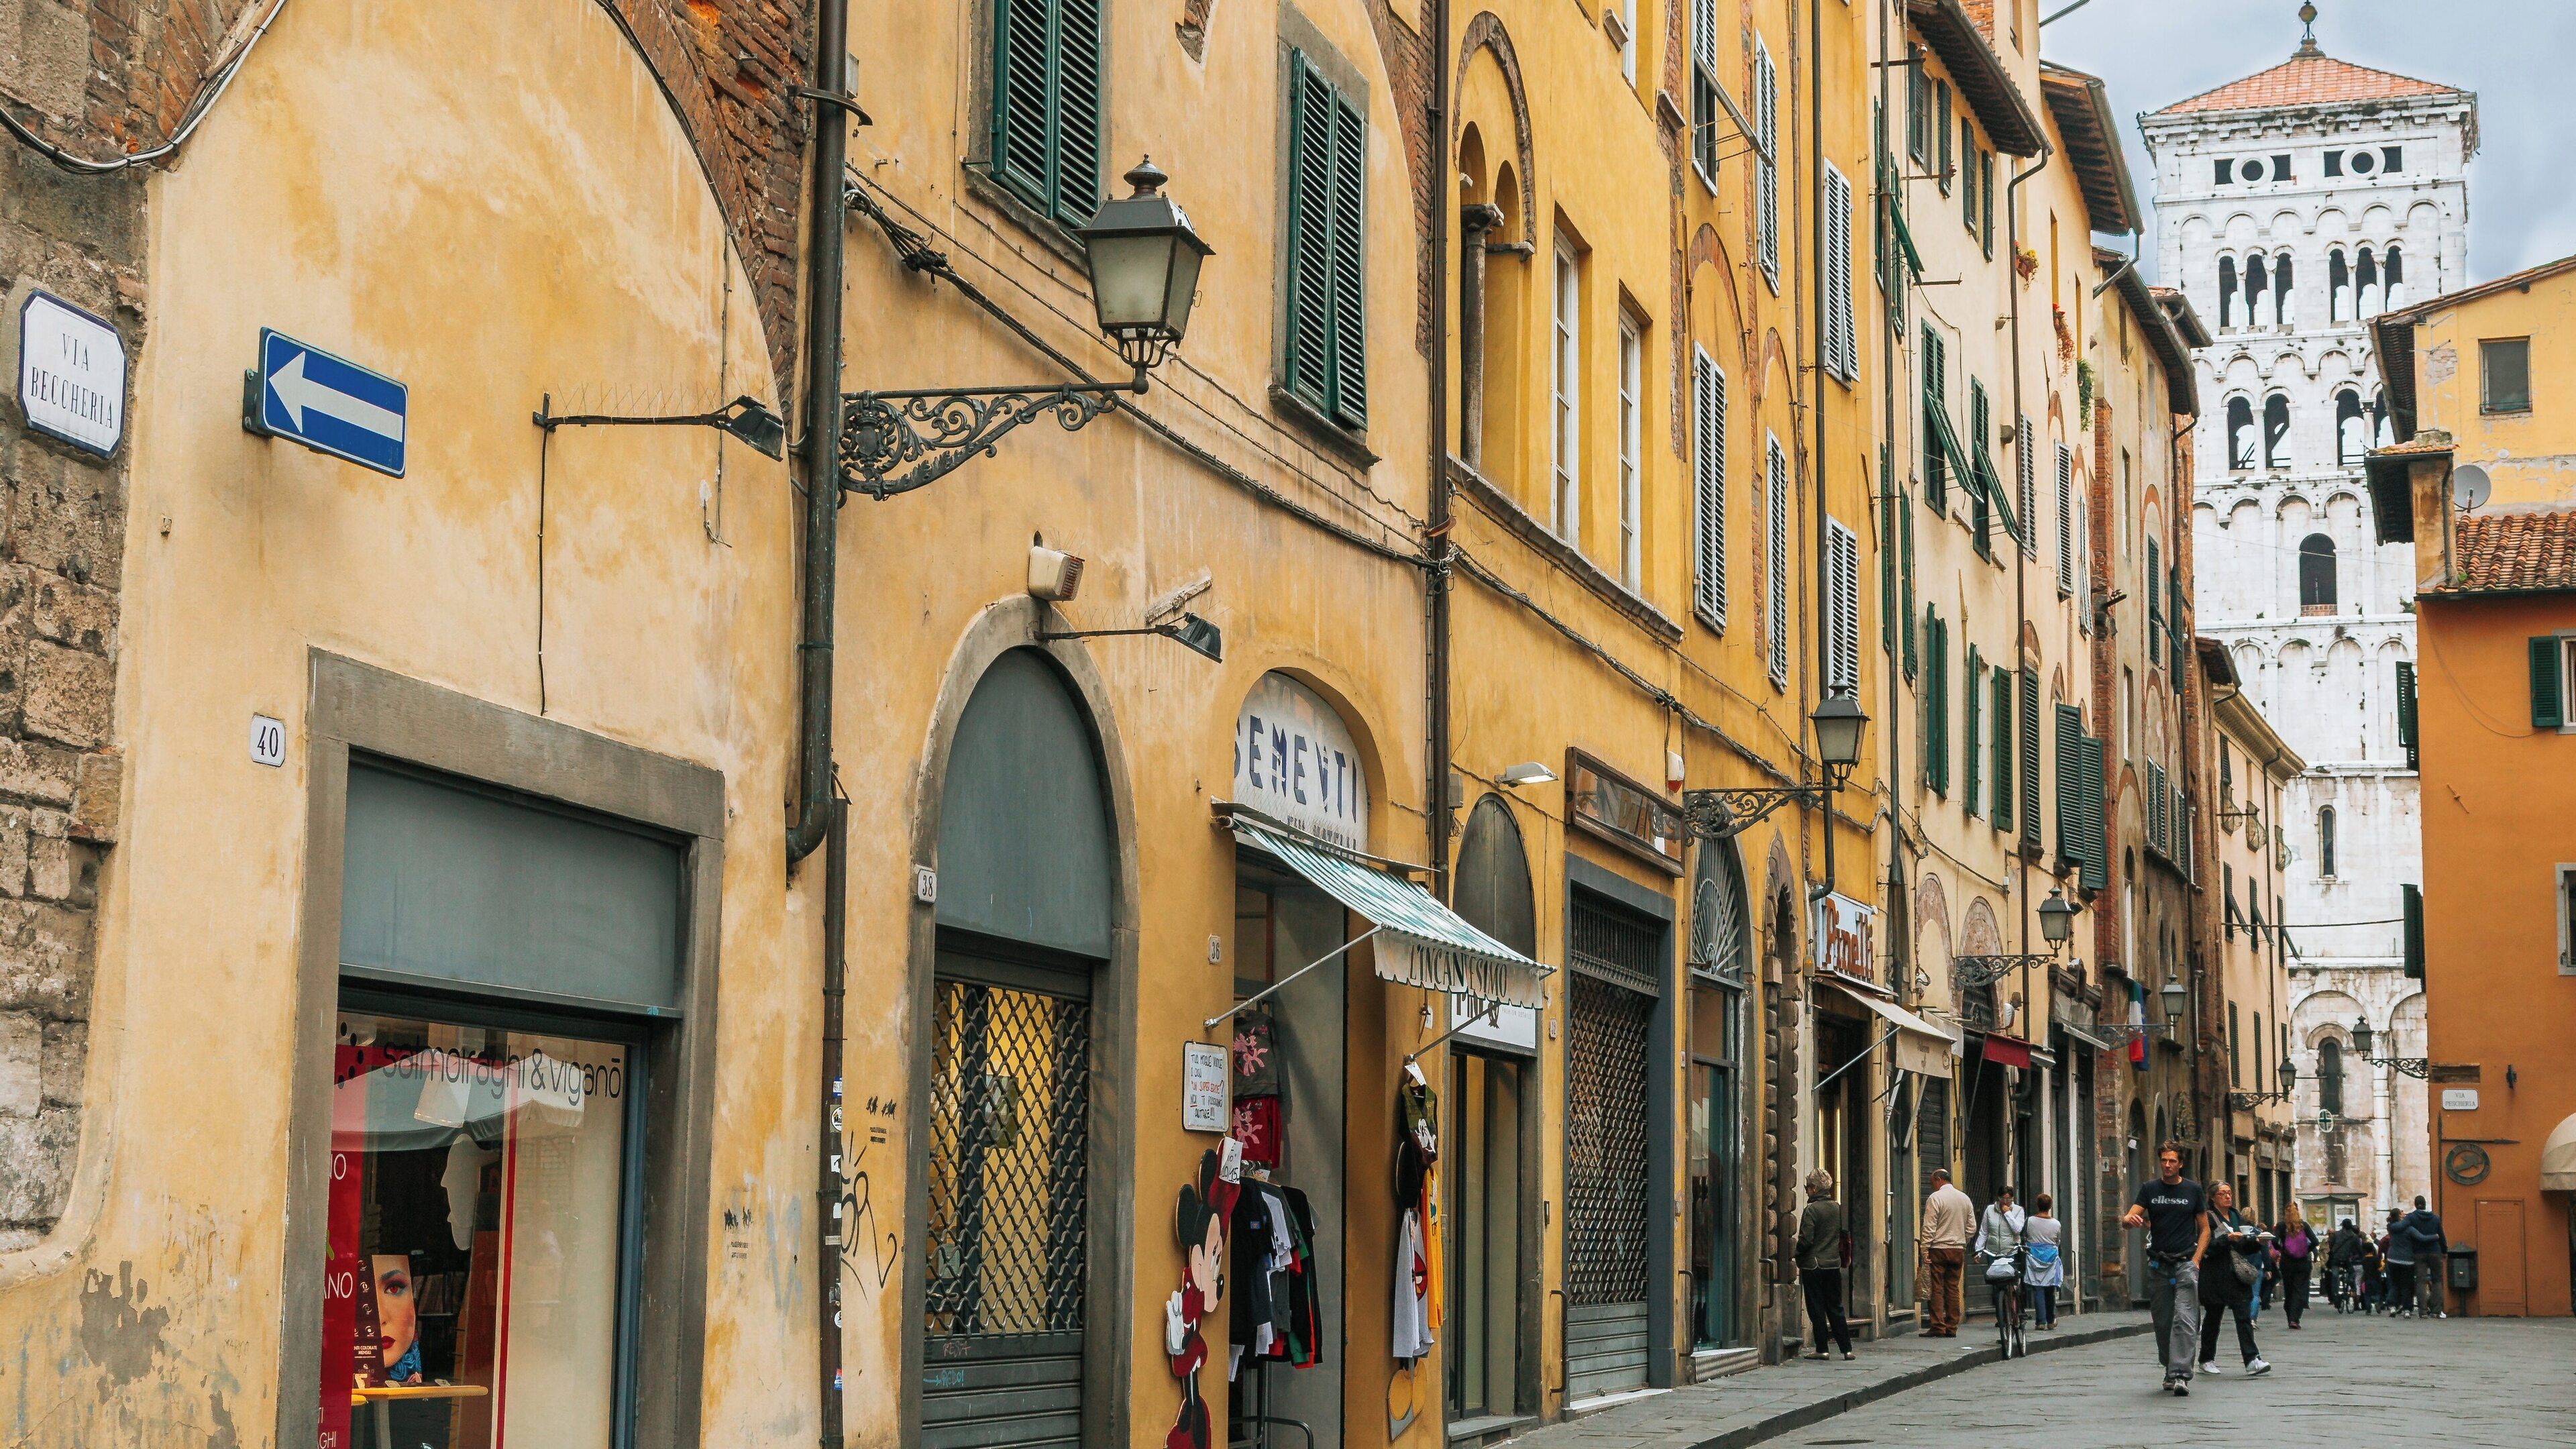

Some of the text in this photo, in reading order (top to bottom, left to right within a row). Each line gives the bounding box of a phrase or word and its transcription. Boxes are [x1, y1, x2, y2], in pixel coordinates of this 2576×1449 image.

[62, 333, 89, 372] VIA
[30, 366, 113, 429] BECCHERIA
[257, 725, 278, 757] 40
[922, 874, 933, 897] 38
[1212, 941, 1220, 960] 36
[1823, 896, 1874, 980] Pinelli
[1409, 943, 1507, 998] L'INCANTESIMO
[531, 1048, 545, 1091] &
[2151, 1195, 2189, 1205] ellesse
[324, 1272, 353, 1299] NO
[317, 1431, 337, 1449] GHI
